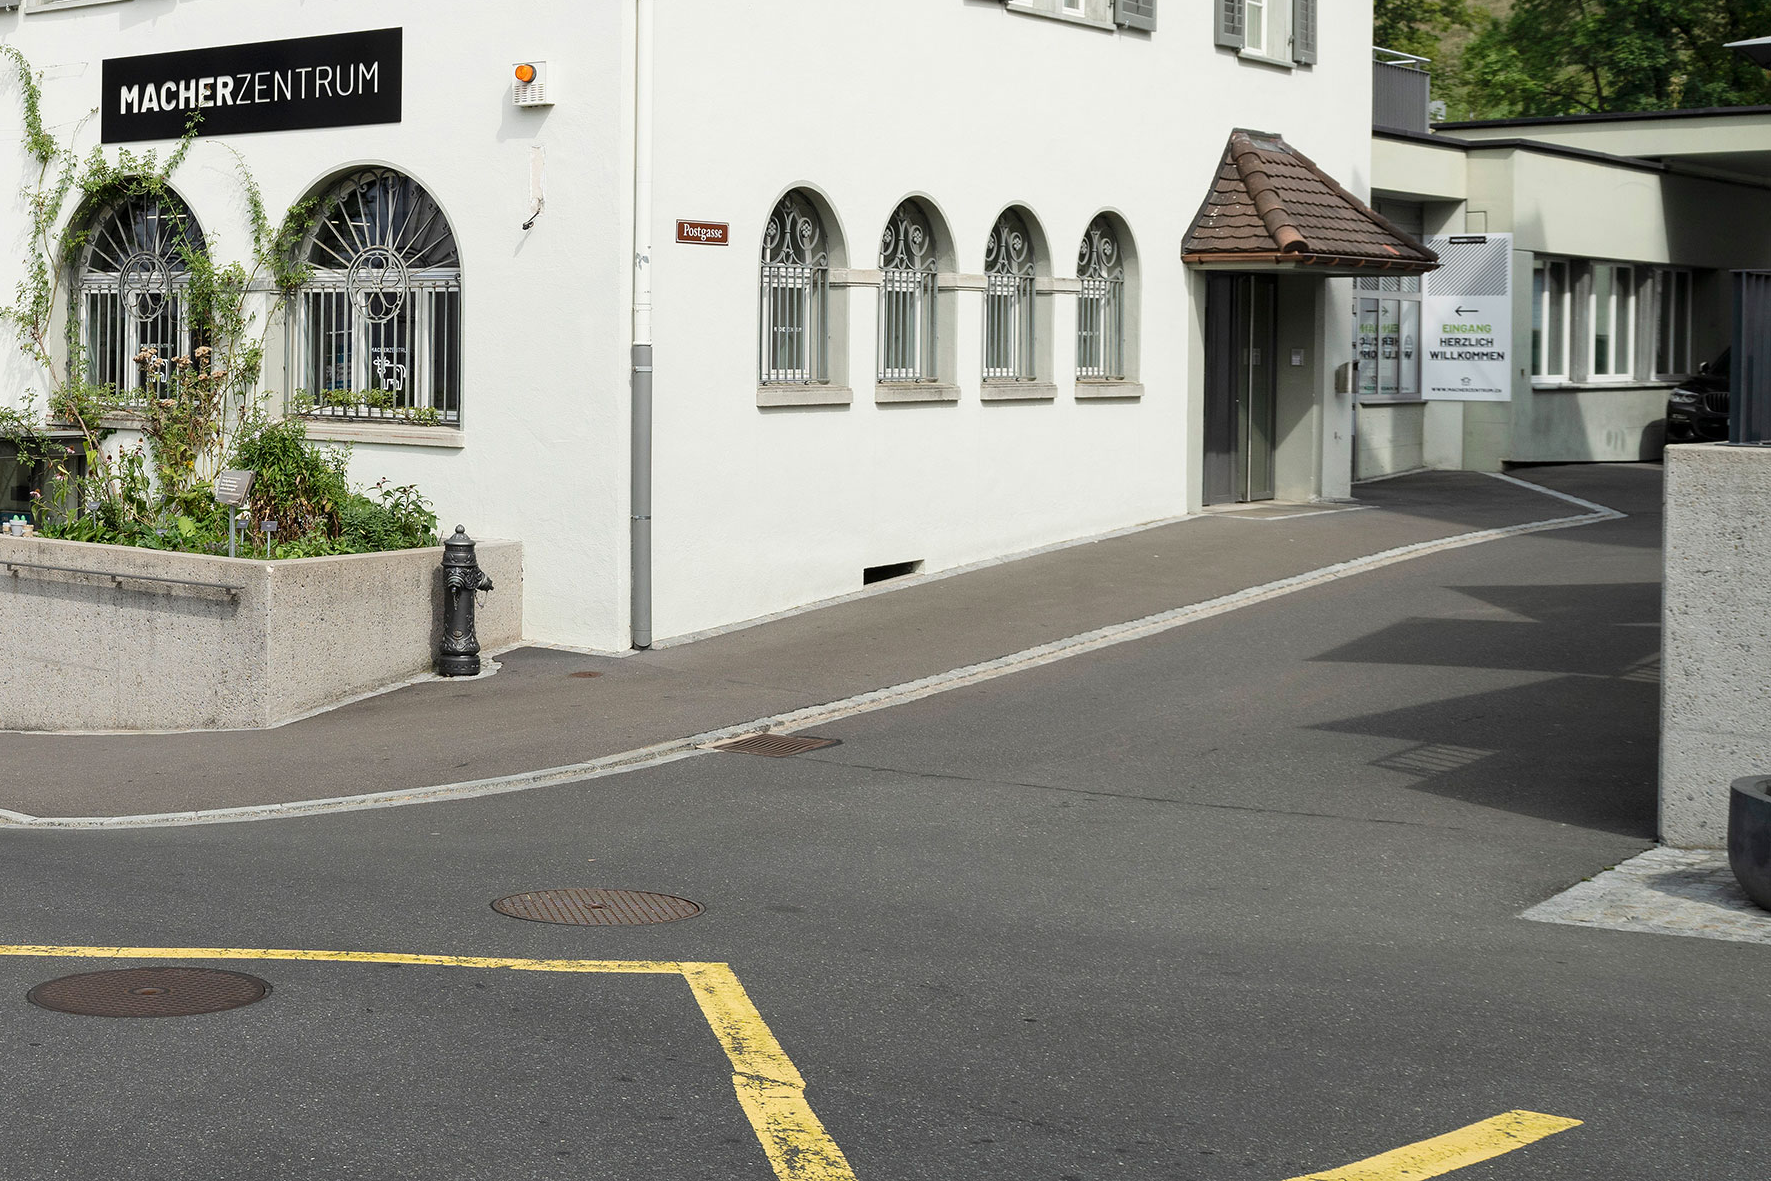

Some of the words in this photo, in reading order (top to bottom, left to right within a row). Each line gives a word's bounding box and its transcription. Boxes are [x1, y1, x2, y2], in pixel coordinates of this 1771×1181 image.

[119, 60, 379, 115] MACHERZENTRUM
[683, 223, 723, 241] Postgasse
[1442, 323, 1492, 334] EINGANG
[1439, 337, 1494, 347] HERZLICH
[1430, 350, 1505, 361] WILLKOMMEN
